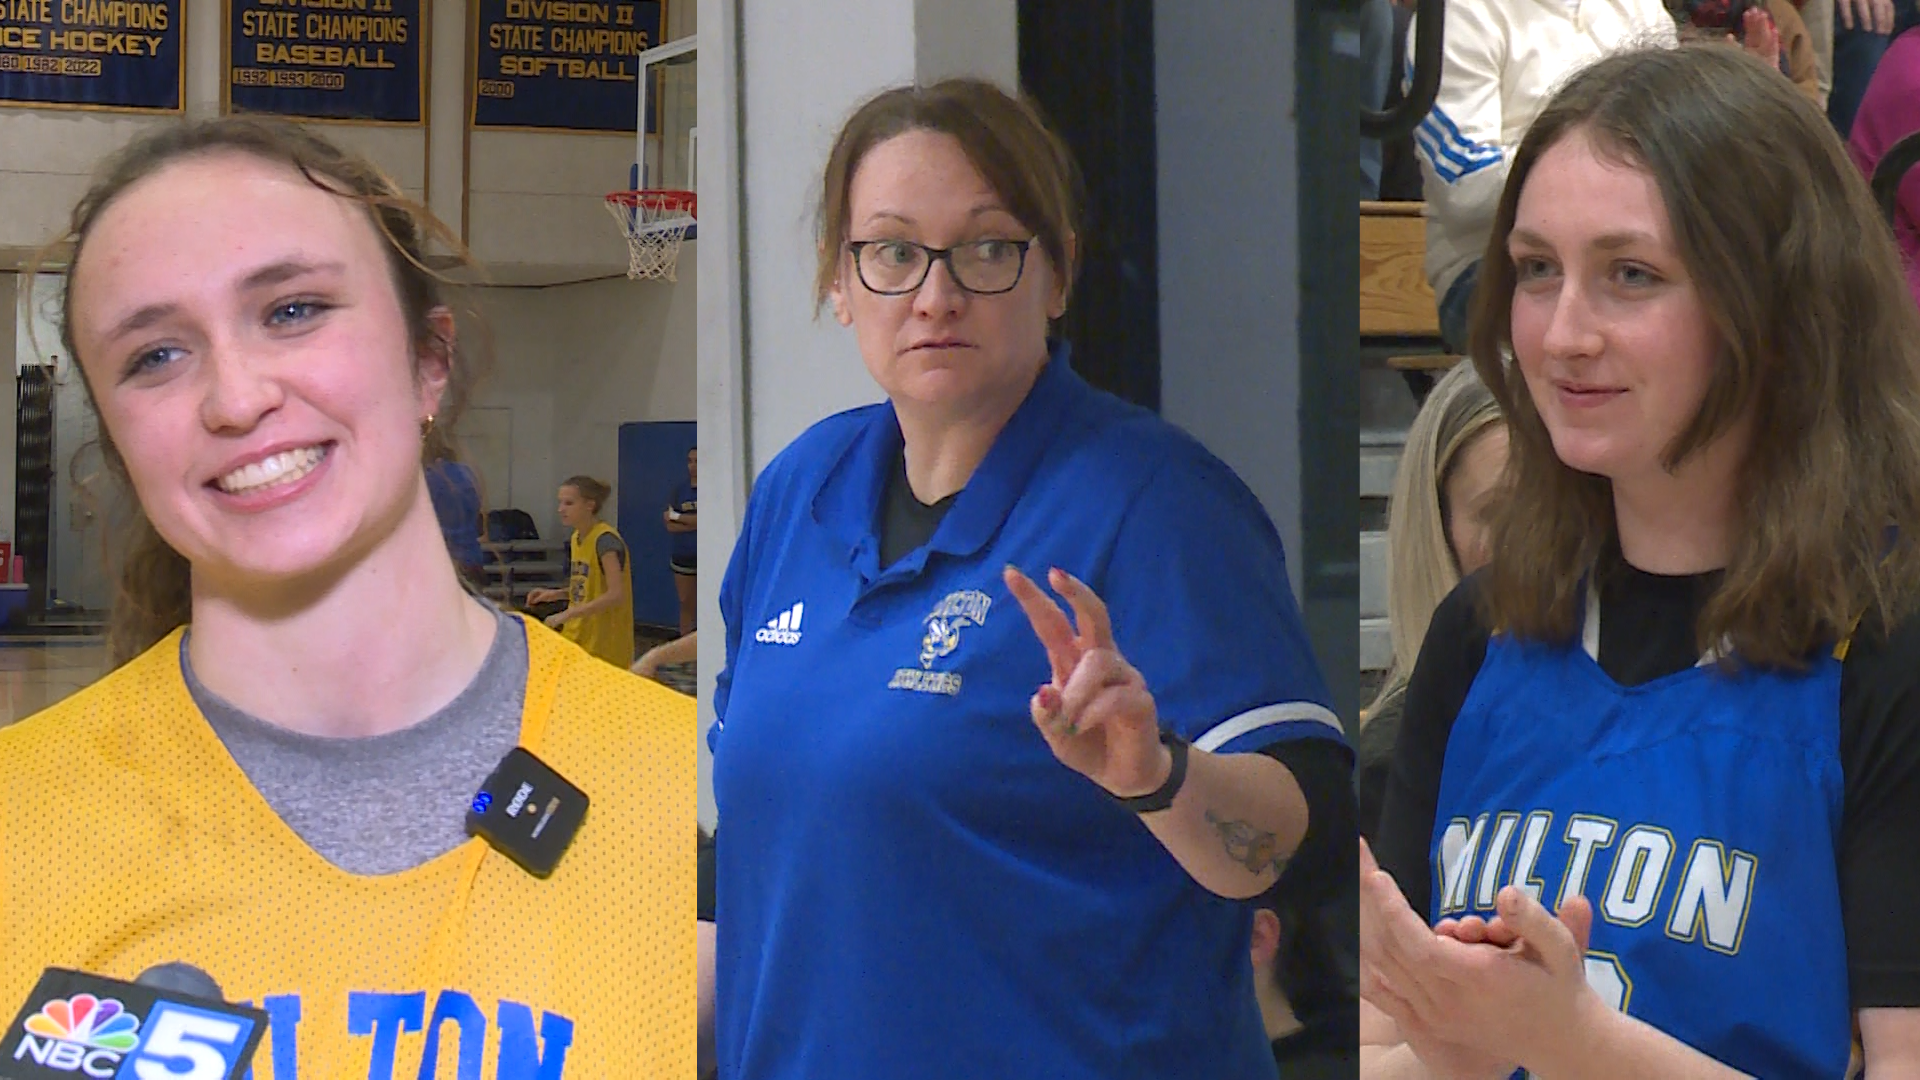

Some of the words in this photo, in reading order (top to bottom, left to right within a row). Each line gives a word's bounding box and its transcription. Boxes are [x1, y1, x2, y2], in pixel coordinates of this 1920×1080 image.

[61, 0, 169, 31] CHAMPIONS
[506, 0, 609, 24] DIVISION
[616, 5, 634, 25] II
[243, 10, 299, 39] STATE
[306, 13, 408, 43] CHAMPIONS
[489, 23, 544, 51] STATE
[551, 27, 648, 56] CHAMPIONS
[50, 29, 163, 56] HOCKEY
[257, 43, 395, 68] BASEBALL
[0, 56, 20, 70] 80
[25, 57, 59, 72] 1982
[64, 59, 99, 74] 2022
[235, 69, 268, 84] 1992
[500, 55, 635, 81] SOFTBALL
[756, 628, 802, 645] adidas
[1437, 810, 1758, 956] MILTON
[14, 1034, 121, 1079] NBC
[134, 1009, 241, 1080] 5
[232, 989, 574, 1080] LTON
